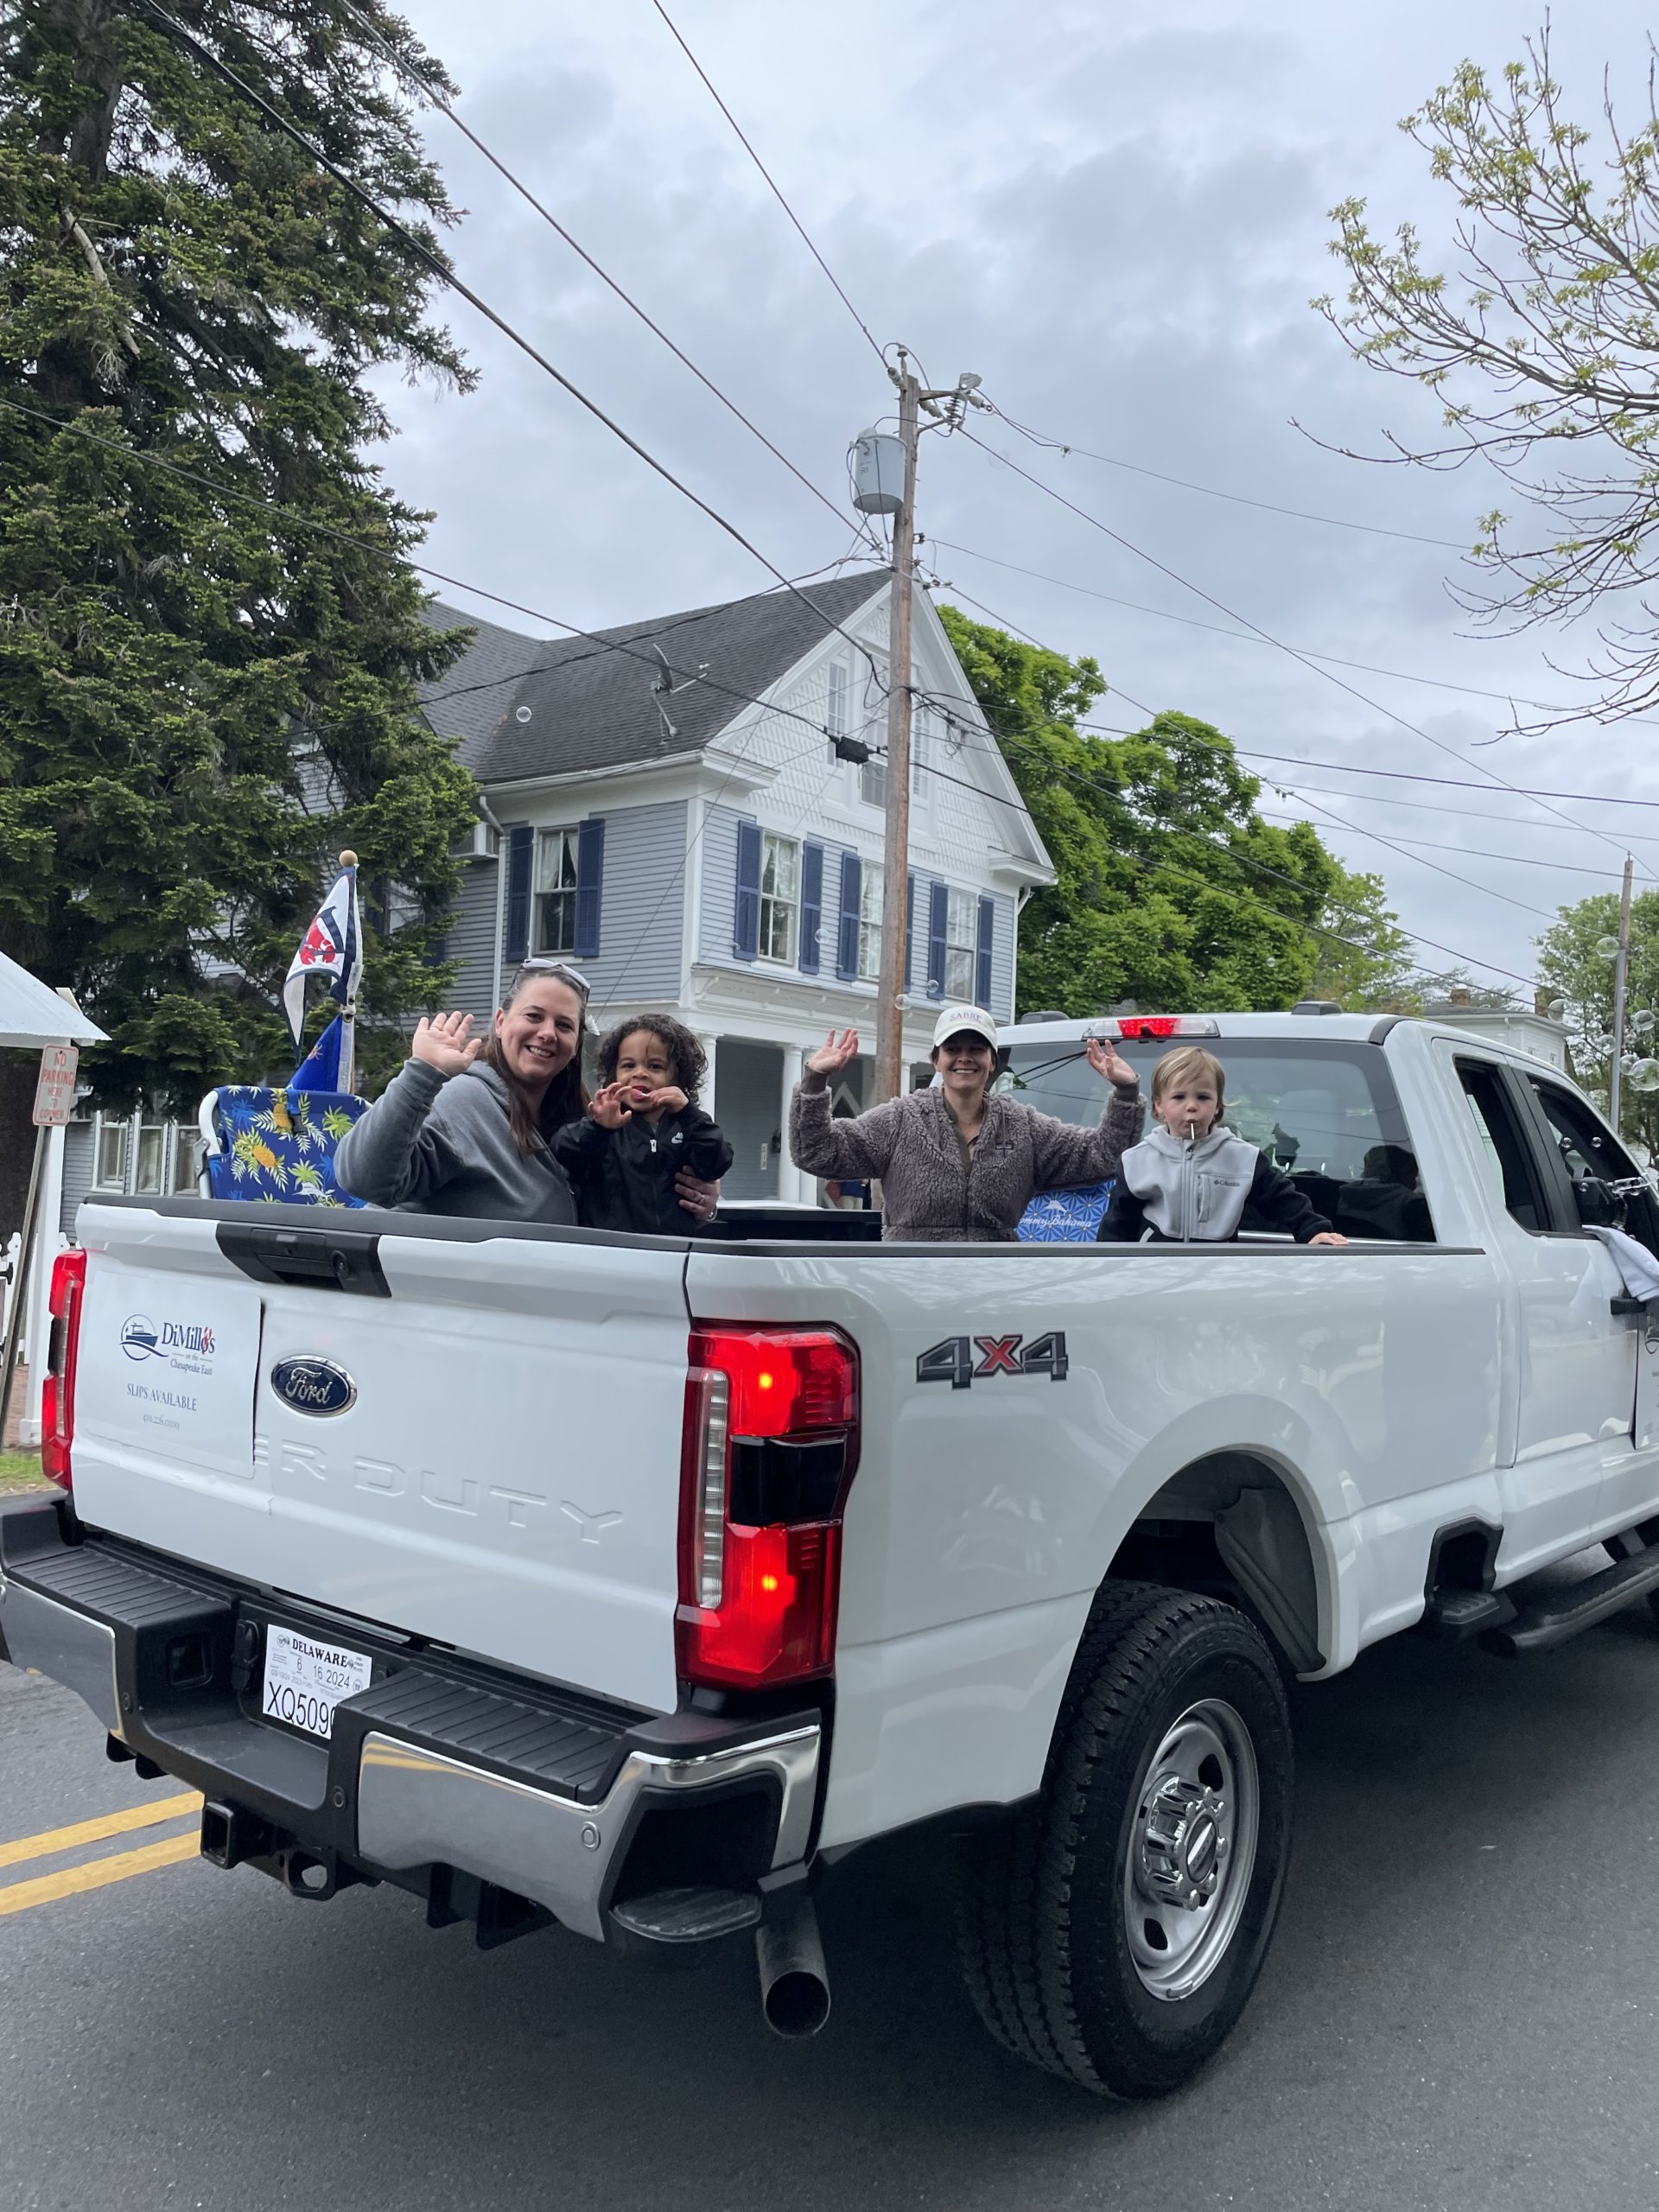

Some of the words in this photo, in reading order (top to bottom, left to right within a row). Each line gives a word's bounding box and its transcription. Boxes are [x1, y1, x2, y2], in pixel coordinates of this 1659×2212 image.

[950, 1011, 982, 1021] SABRE
[54, 1052, 67, 1067] NO
[41, 1069, 74, 1086] PARKING
[48, 1087, 63, 1097] HERE
[1020, 1217, 1049, 1230] ommy
[1051, 1215, 1092, 1228] Bahama
[170, 1358, 200, 1374] Chesapeake
[200, 1364, 213, 1376] East
[916, 1331, 1069, 1390] 4X4
[127, 1382, 149, 1400] SLIPS
[150, 1389, 198, 1412] AVAILABLE
[285, 1367, 333, 1405] Ford
[354, 1455, 623, 1544] DUTY
[292, 1638, 347, 1668] DELAWARE
[297, 1657, 302, 1672] 6
[314, 1664, 323, 1681] 16
[326, 1669, 350, 1689] 2024
